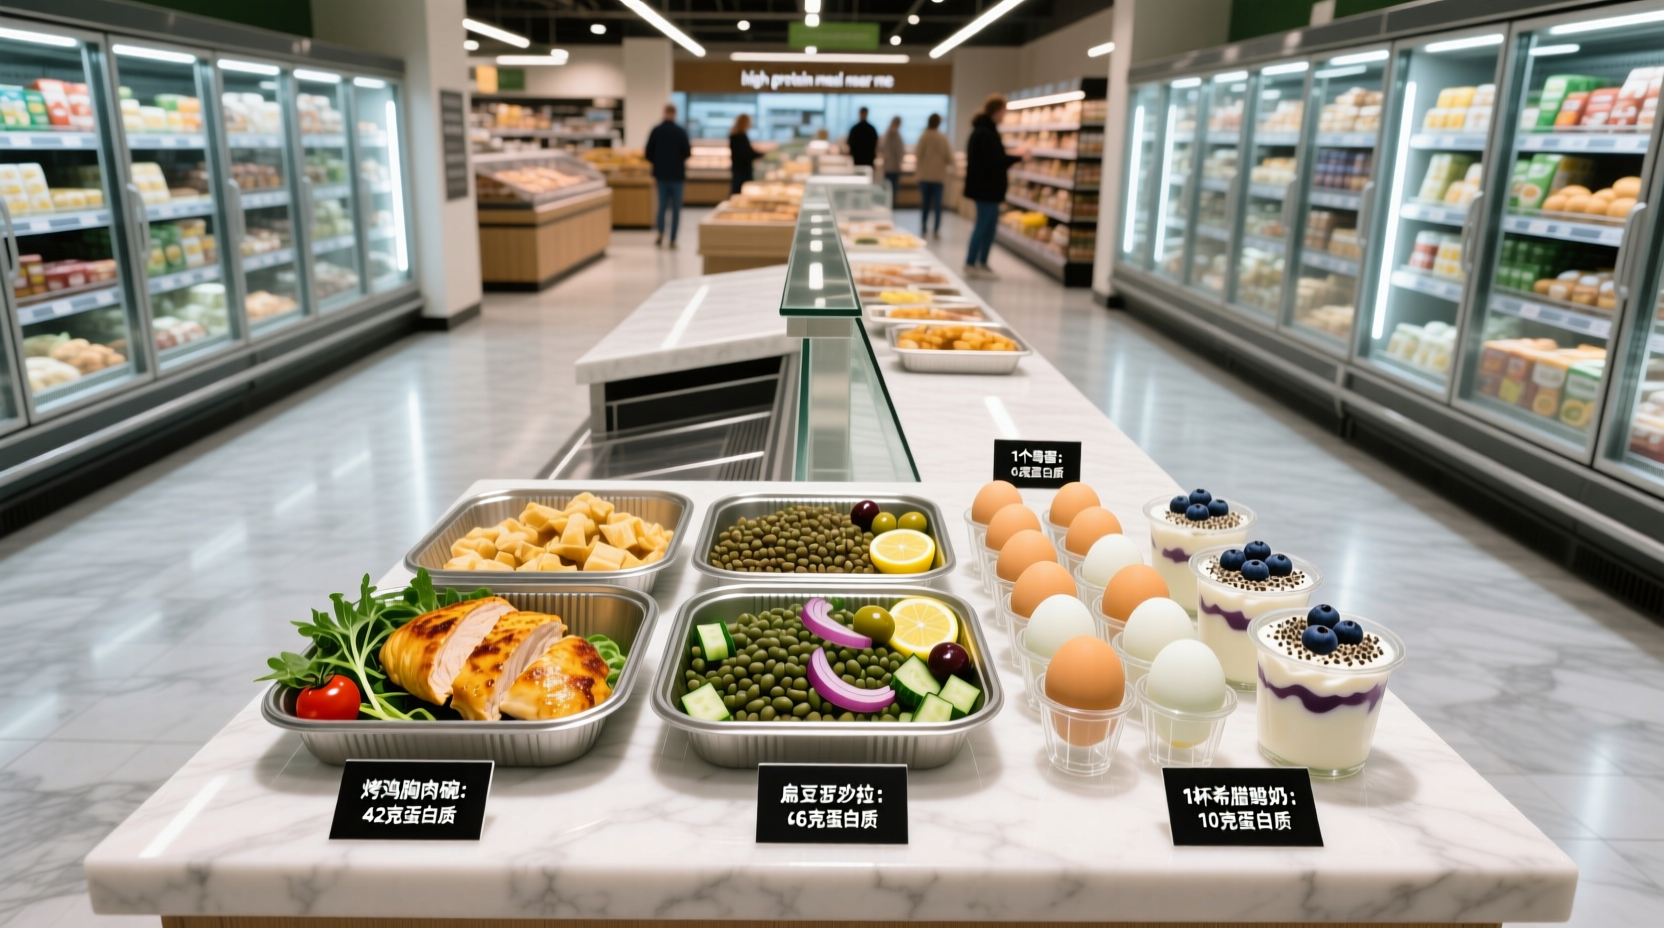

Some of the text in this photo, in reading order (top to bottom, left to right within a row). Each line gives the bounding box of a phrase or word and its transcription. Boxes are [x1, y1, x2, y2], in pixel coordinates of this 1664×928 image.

[741, 70, 769, 89] high
[361, 804, 458, 825] 42克蛋白质
[1197, 810, 1292, 830] 10克蛋白质
